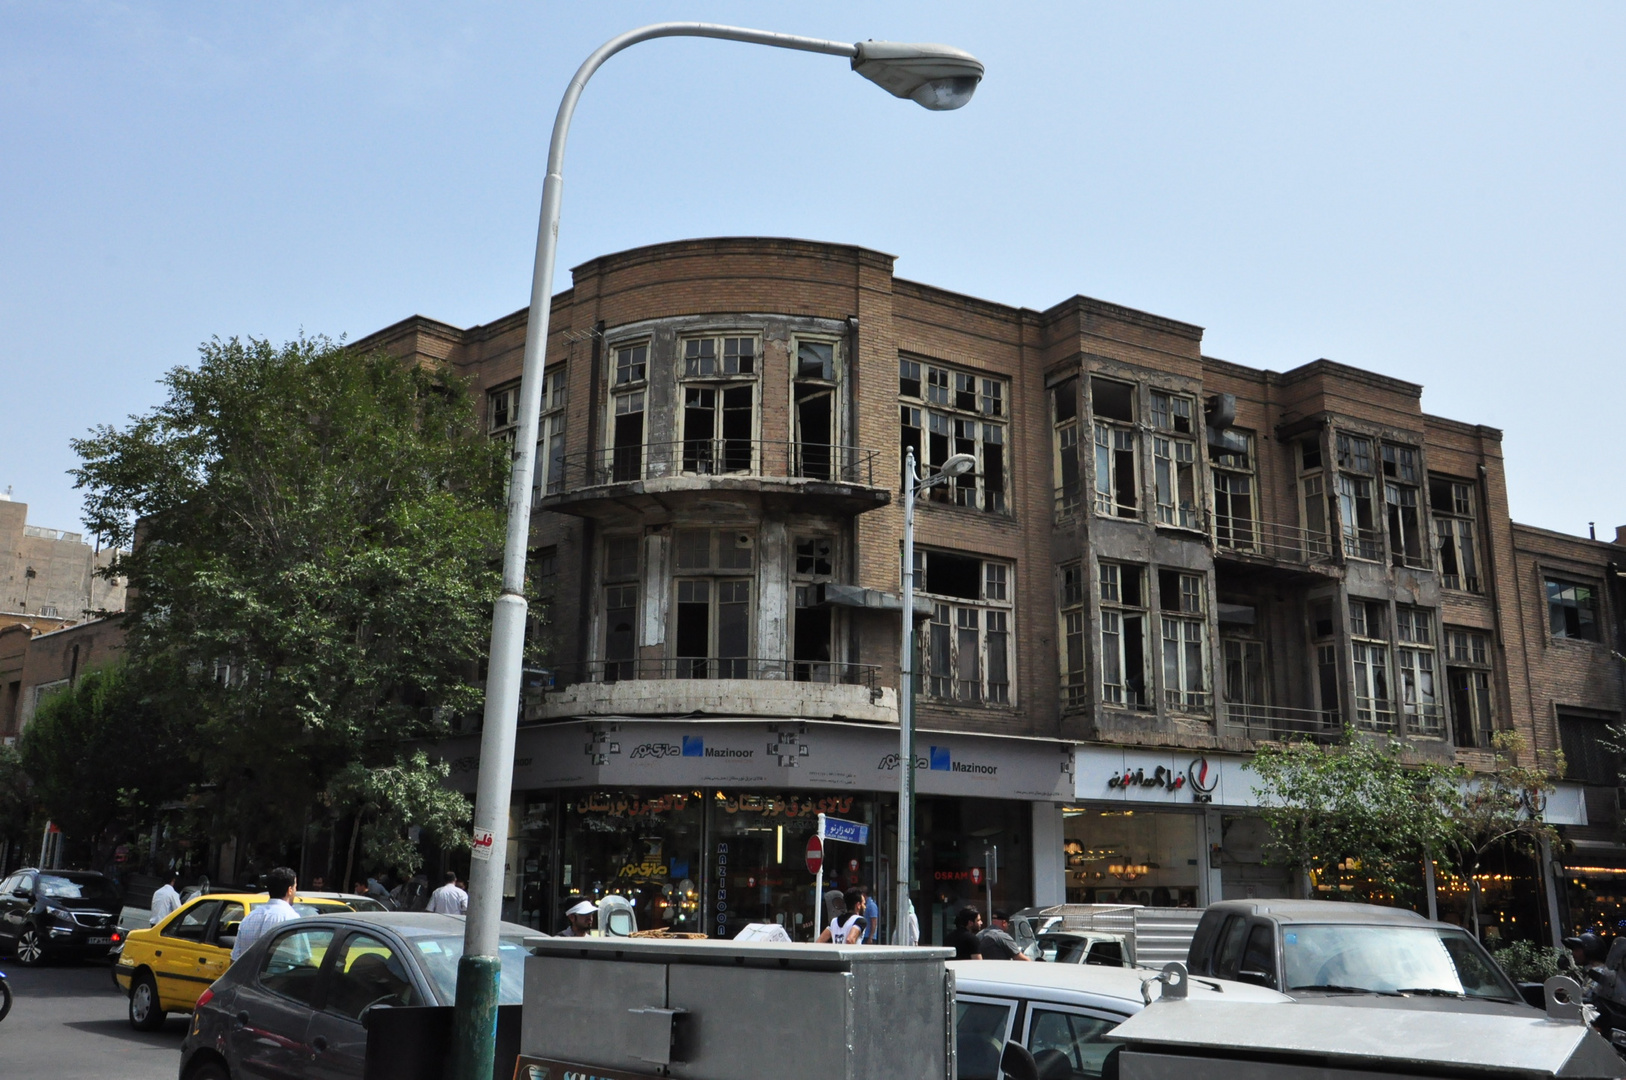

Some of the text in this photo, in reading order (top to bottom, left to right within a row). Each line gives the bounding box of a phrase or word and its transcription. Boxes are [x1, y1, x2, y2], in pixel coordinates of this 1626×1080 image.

[705, 747, 754, 758] Mazinoor
[952, 761, 998, 775] Mazinoor
[934, 871, 969, 880] OSRAM
